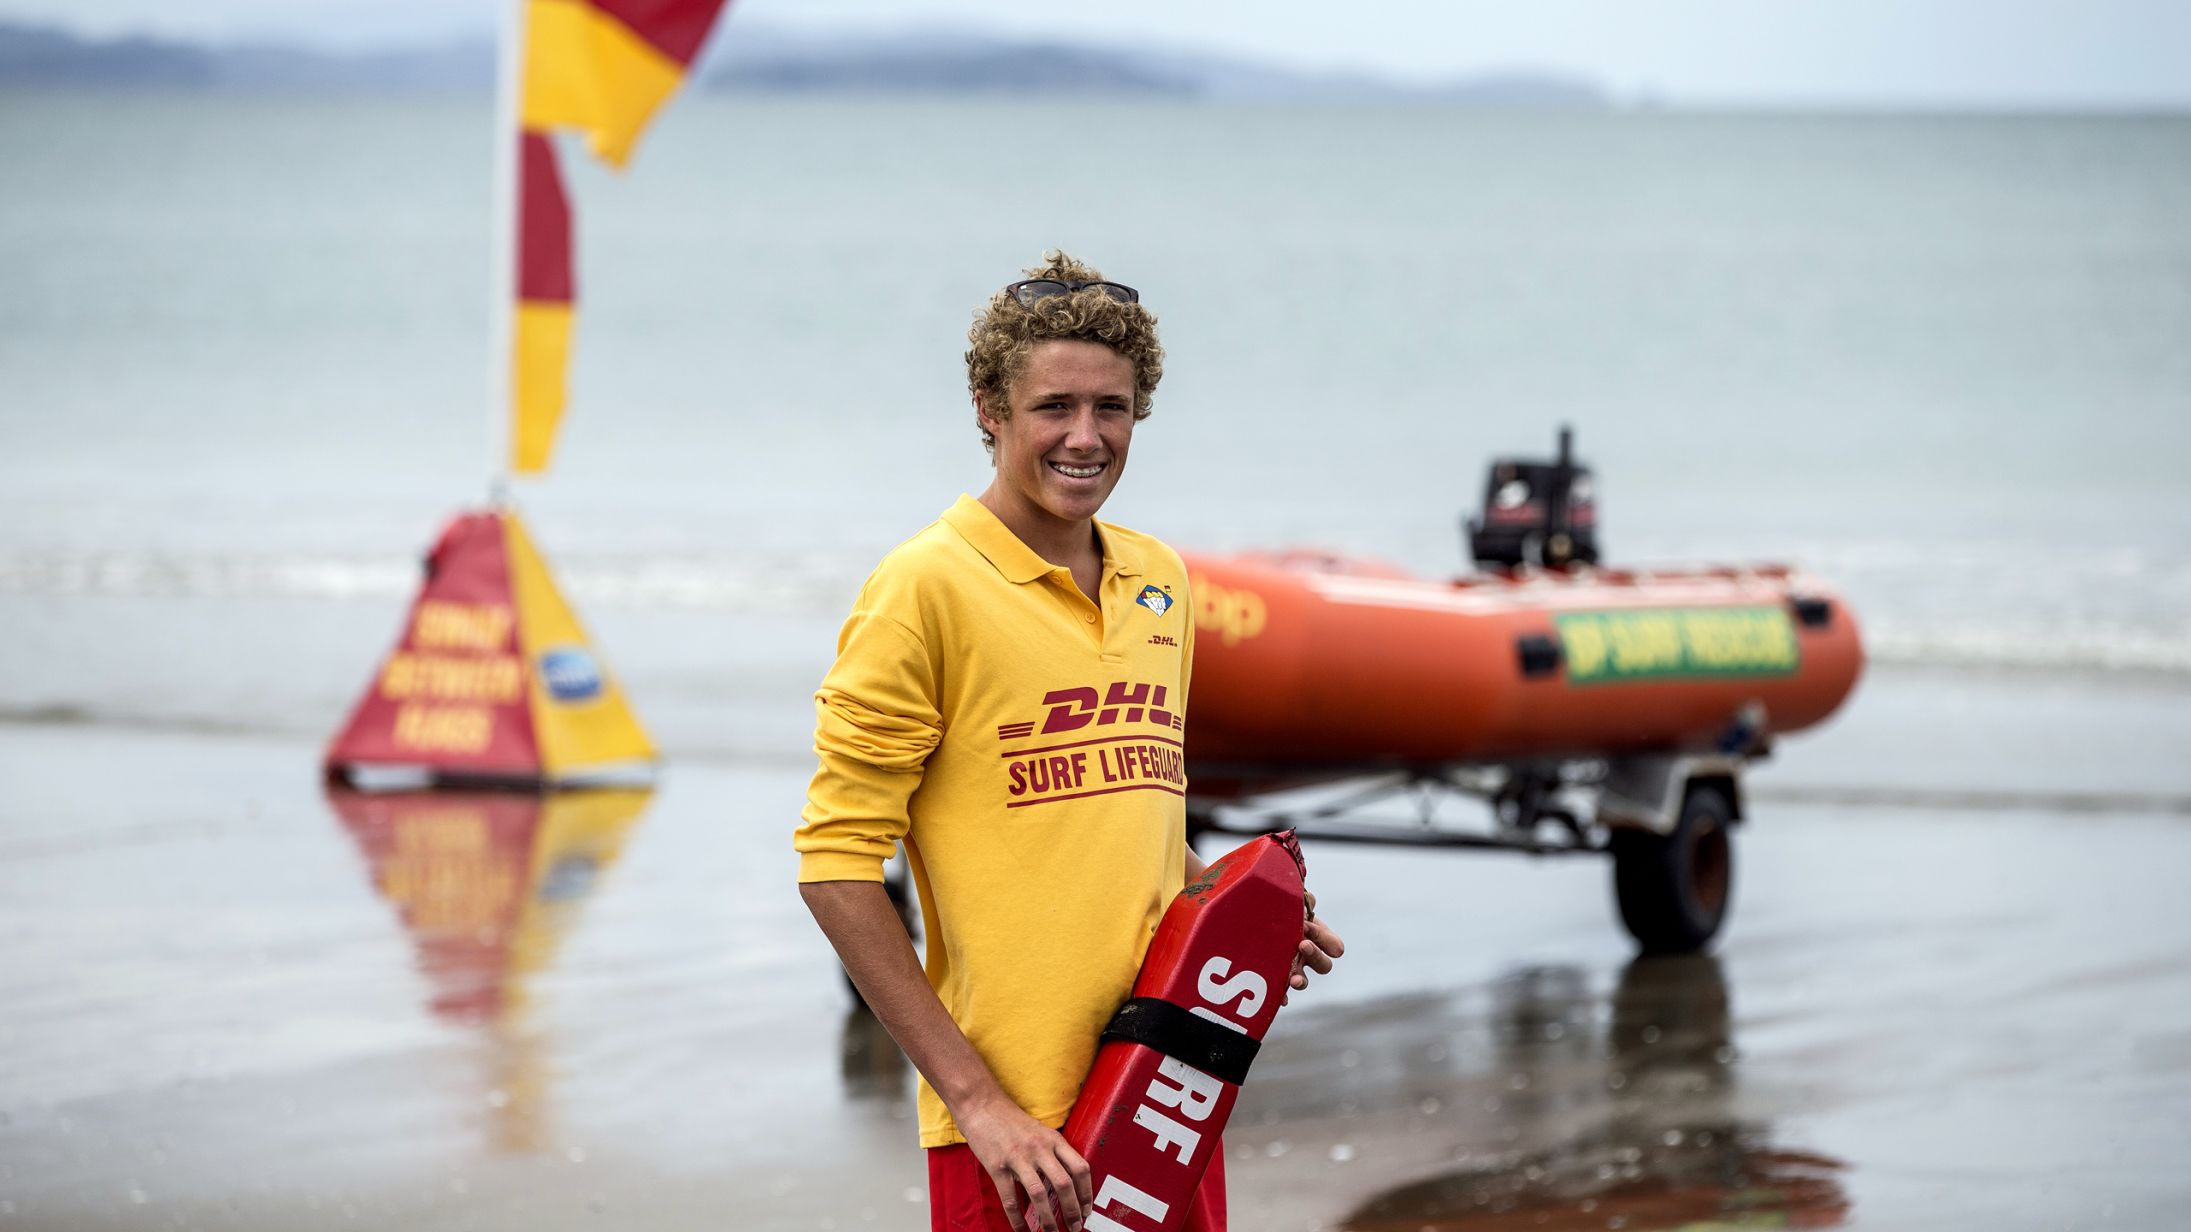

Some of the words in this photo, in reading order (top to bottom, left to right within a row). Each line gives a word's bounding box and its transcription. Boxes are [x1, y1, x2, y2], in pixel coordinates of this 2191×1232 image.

[1153, 635, 1175, 647] DHL
[1041, 682, 1172, 735] DHL
[1008, 752, 1087, 796] SURF
